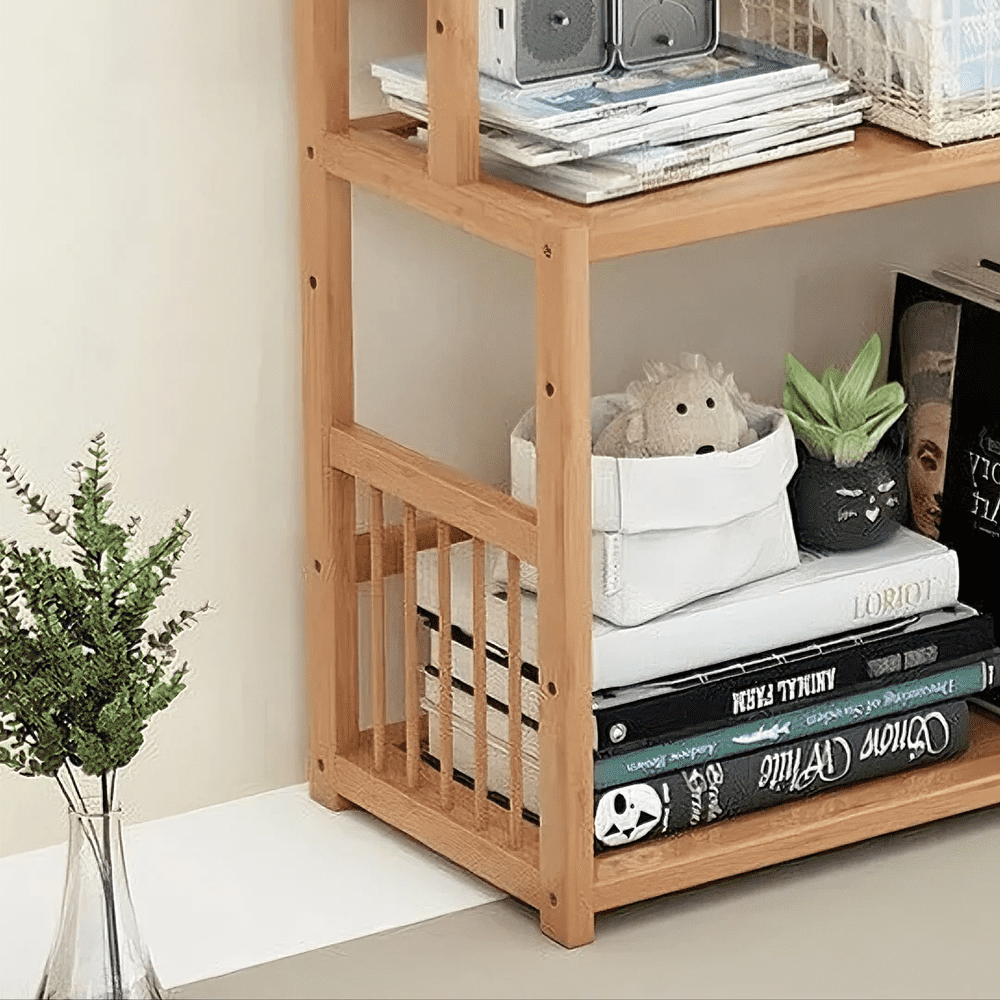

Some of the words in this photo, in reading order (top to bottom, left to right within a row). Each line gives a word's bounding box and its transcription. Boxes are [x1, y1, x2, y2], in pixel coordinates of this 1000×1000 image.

[731, 683, 774, 715] FARM
[777, 667, 836, 699] ANIMAL
[859, 711, 951, 762] Snow
[758, 736, 851, 792] White
